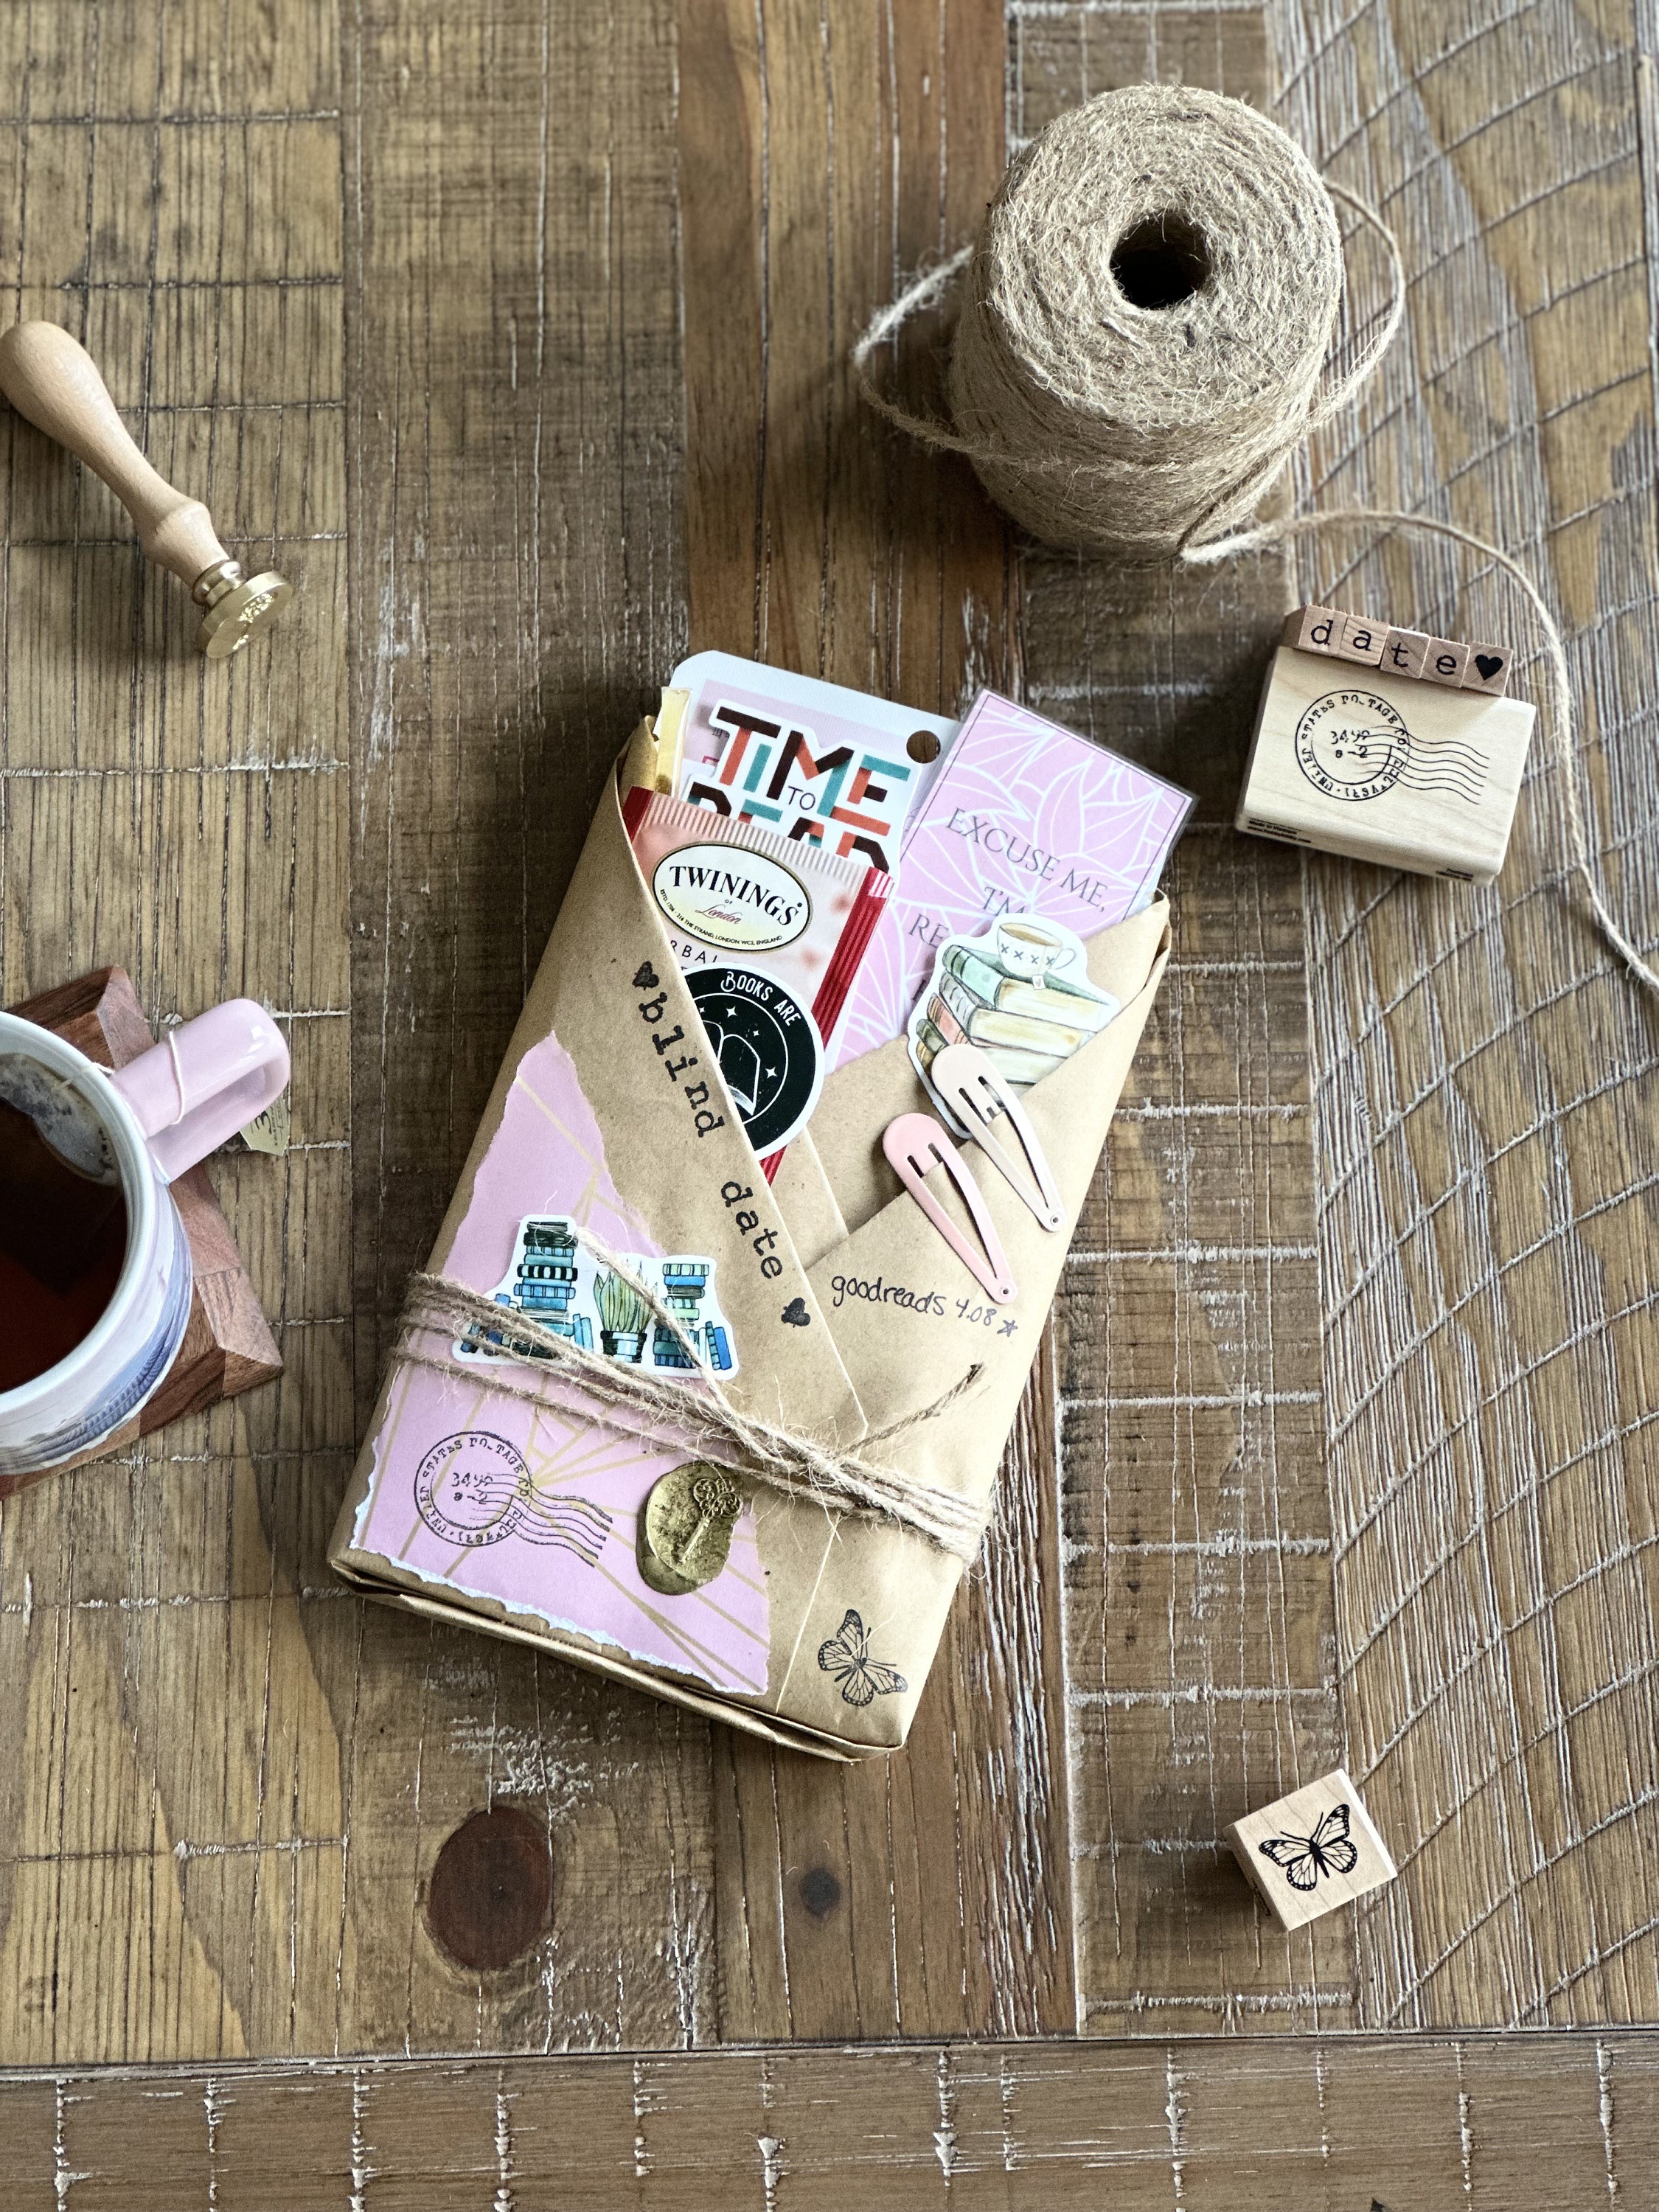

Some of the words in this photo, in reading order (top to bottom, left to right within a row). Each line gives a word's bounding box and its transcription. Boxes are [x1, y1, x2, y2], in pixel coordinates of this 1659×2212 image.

[1311, 619, 1457, 675] date
[1341, 695, 1398, 724] POTAGE
[717, 706, 911, 836] TIME
[788, 785, 816, 810] TO
[946, 808, 1060, 880] EXCUSE
[1060, 869, 1107, 912] ME,
[669, 866, 798, 925] TWININGS
[695, 904, 742, 925] London
[684, 919, 694, 928] THE
[715, 935, 740, 944] LONDON
[756, 935, 782, 945] ENGLAND
[720, 971, 773, 1001] BOOKS
[773, 999, 801, 1026] ARE
[639, 992, 725, 1137] blind
[721, 1181, 782, 1279] date
[832, 1276, 946, 1315] goodreads
[956, 1298, 997, 1326] 4.08
[469, 1438, 524, 1474] POTAGE
